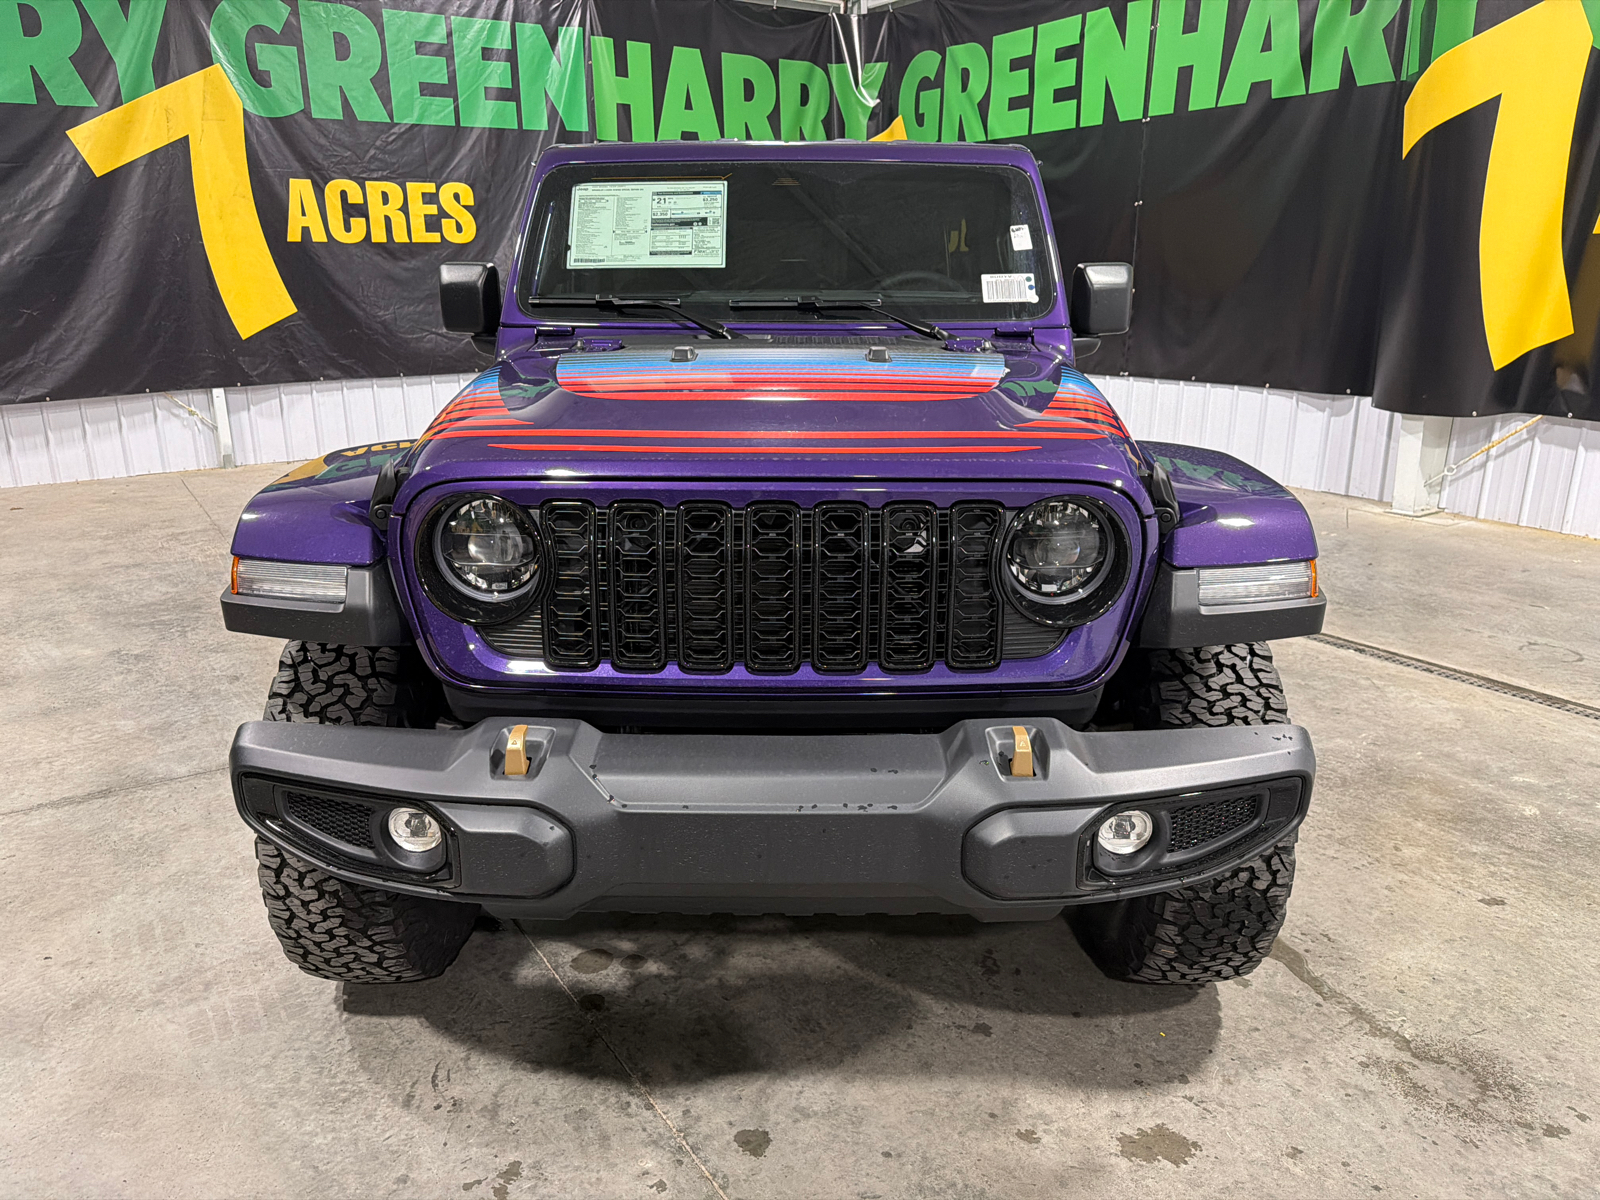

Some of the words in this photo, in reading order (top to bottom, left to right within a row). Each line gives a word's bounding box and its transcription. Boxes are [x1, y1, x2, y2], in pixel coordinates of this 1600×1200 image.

[209, 0, 589, 132] GREEN
[590, 35, 888, 142] HARRY
[898, 0, 1152, 143] GREEN
[65, 63, 297, 340] 7
[287, 178, 477, 244] ACRES
[656, 197, 667, 205] 21
[1402, 0, 1594, 371] 7
